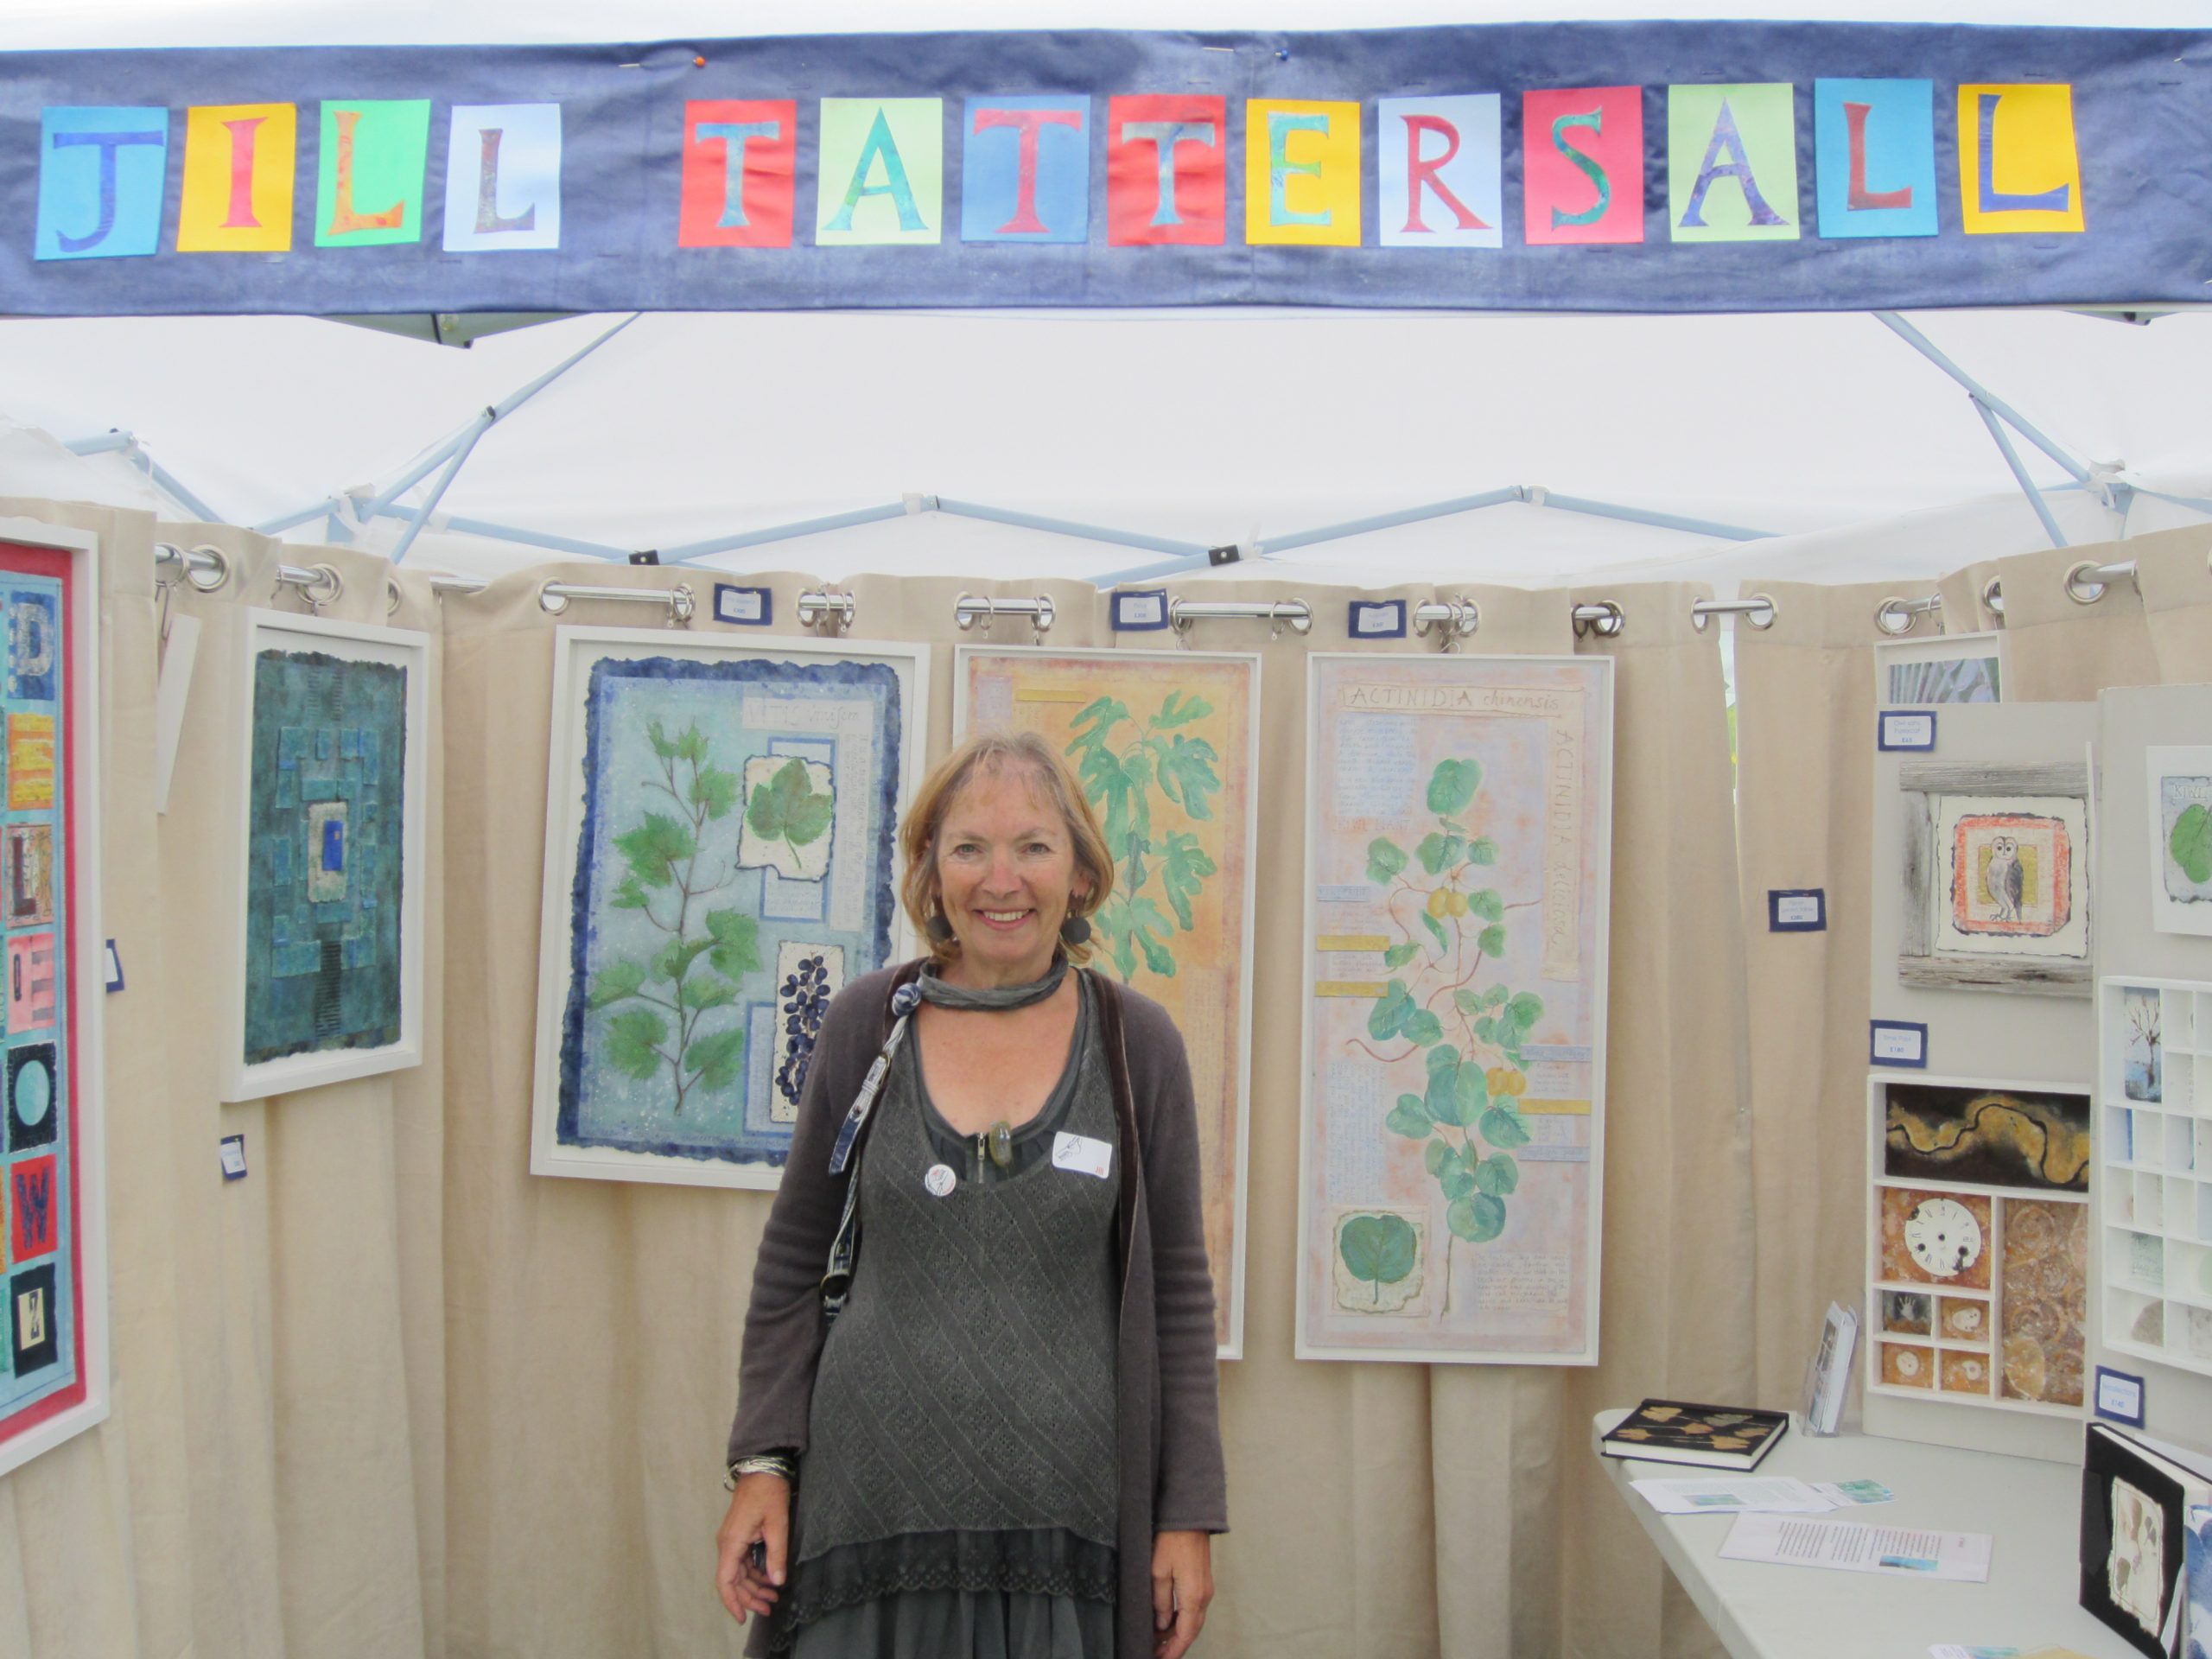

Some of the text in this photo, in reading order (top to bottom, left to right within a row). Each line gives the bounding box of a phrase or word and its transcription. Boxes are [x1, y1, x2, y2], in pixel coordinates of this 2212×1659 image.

[54, 93, 2070, 252] JILL TATTERSALL
[1350, 686, 1473, 709] ACTINIDIA
[1554, 729, 1575, 847] ACTINIDIA
